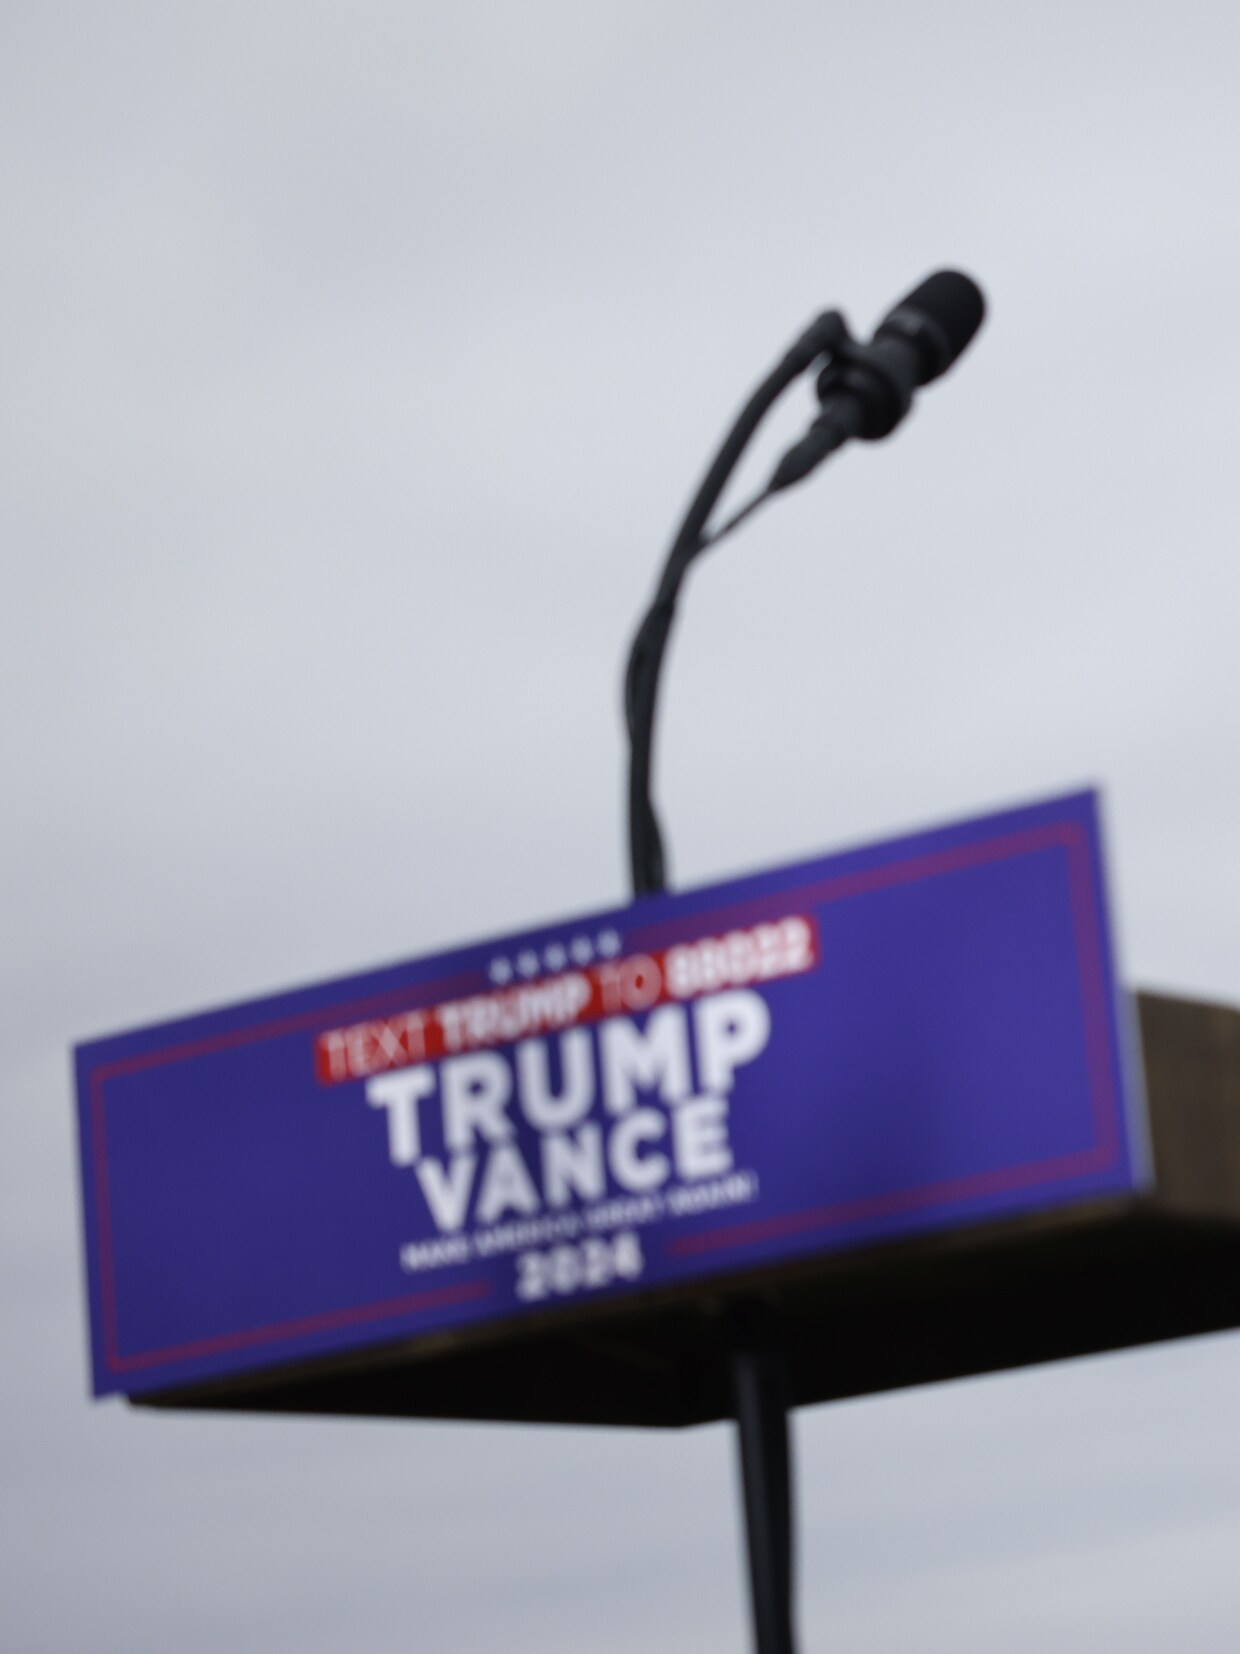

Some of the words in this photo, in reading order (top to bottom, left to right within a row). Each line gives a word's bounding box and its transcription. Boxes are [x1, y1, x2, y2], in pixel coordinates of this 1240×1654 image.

[323, 1011, 427, 1080] TEXT
[438, 972, 591, 1050] TRUMP
[593, 953, 661, 1013] TO
[666, 917, 812, 997] 88022
[367, 990, 769, 1165] TRUMP
[418, 1098, 732, 1230] VANCE
[516, 1230, 643, 1300] 2024
